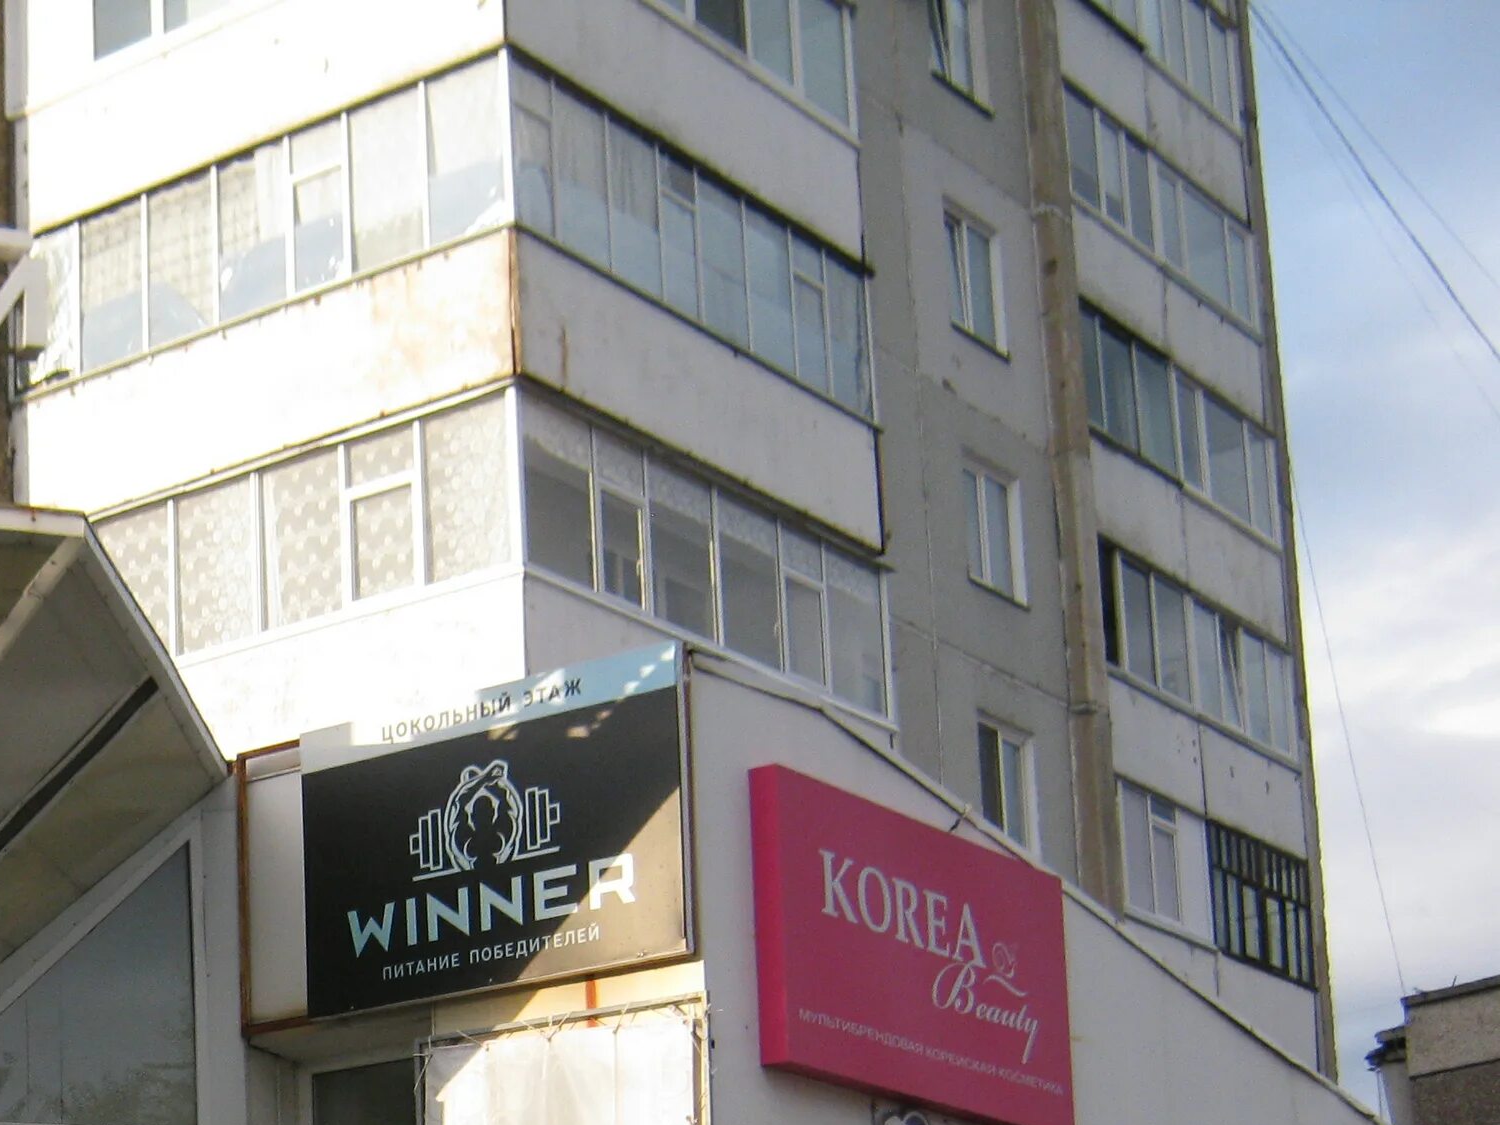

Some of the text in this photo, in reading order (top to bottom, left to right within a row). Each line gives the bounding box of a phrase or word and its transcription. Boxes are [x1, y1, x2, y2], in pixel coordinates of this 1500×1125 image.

[382, 678, 581, 743] ЦОКОЛЬНЫЙ ЭТАЖ
[347, 853, 635, 957] WINNER
[383, 924, 599, 981] ПИТАНИЕ ПОБЕДИТЕЛЕЙ
[819, 849, 987, 968] KOREA
[931, 961, 1040, 1065] Beauty
